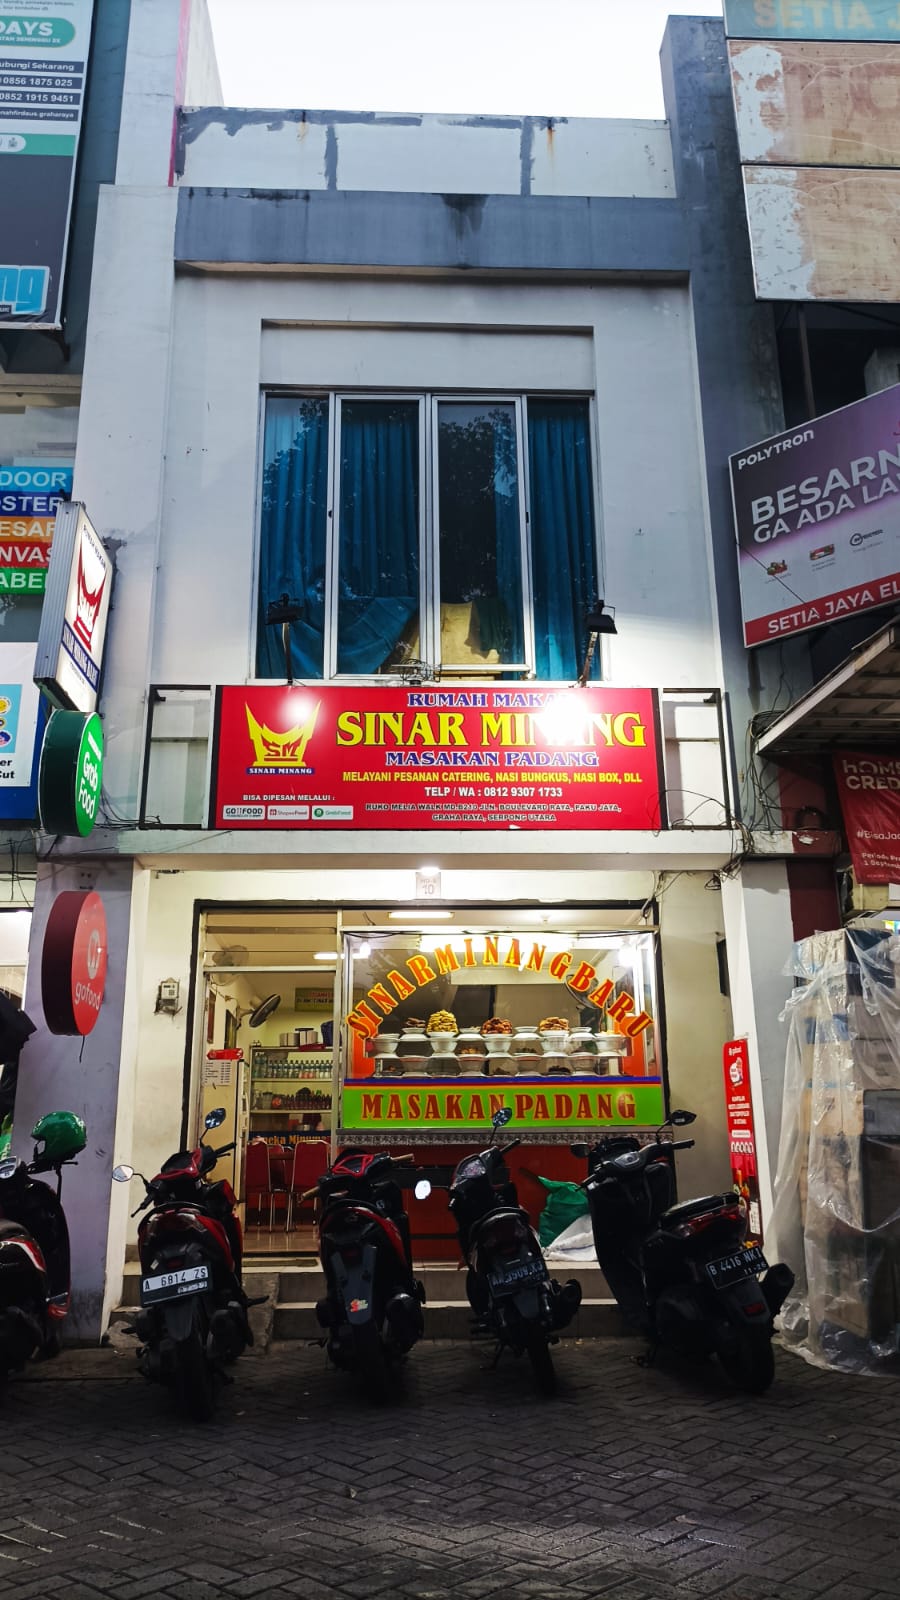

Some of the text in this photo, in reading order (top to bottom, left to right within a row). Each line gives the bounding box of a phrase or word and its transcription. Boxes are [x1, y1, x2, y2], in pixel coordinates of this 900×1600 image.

[753, 0, 875, 30] SETIA
[31, 62, 75, 72] Sekarang
[3, 77, 73, 87] 0856 1875 025
[0, 93, 74, 103] 0852 1915 9451
[0, 471, 67, 487] DOOR
[753, 473, 900, 544] GA ADA LA
[0, 572, 48, 588] ABE
[768, 608, 820, 635] SETIA
[824, 590, 875, 617] JAYA
[407, 693, 488, 708] RUMAH
[336, 711, 469, 747] SINAR
[385, 751, 599, 767] MASAKAN PADANG
[83, 751, 98, 792] Grab
[342, 771, 391, 781] MELAYANI
[394, 771, 438, 782] PESANAN
[441, 772, 493, 783] CATERING,
[495, 772, 518, 782] NASI
[521, 772, 571, 784] BUNGKUS,
[573, 773, 596, 782] NASI
[598, 773, 621, 784] BOX,
[424, 787, 450, 797] TELP
[458, 787, 475, 797] WA
[483, 787, 508, 797] 0812
[510, 787, 535, 797] 9307
[538, 787, 563, 797] 1733
[365, 803, 390, 811] RUKO
[391, 803, 416, 811] MELIA
[432, 814, 461, 822] GRAHA
[487, 814, 527, 822] SERPONG
[528, 814, 557, 822] UTARA
[75, 982, 101, 1010] gofood
[362, 1093, 638, 1120] MASAKAN PADANG
[145, 1267, 206, 1290] A 6814 ZS
